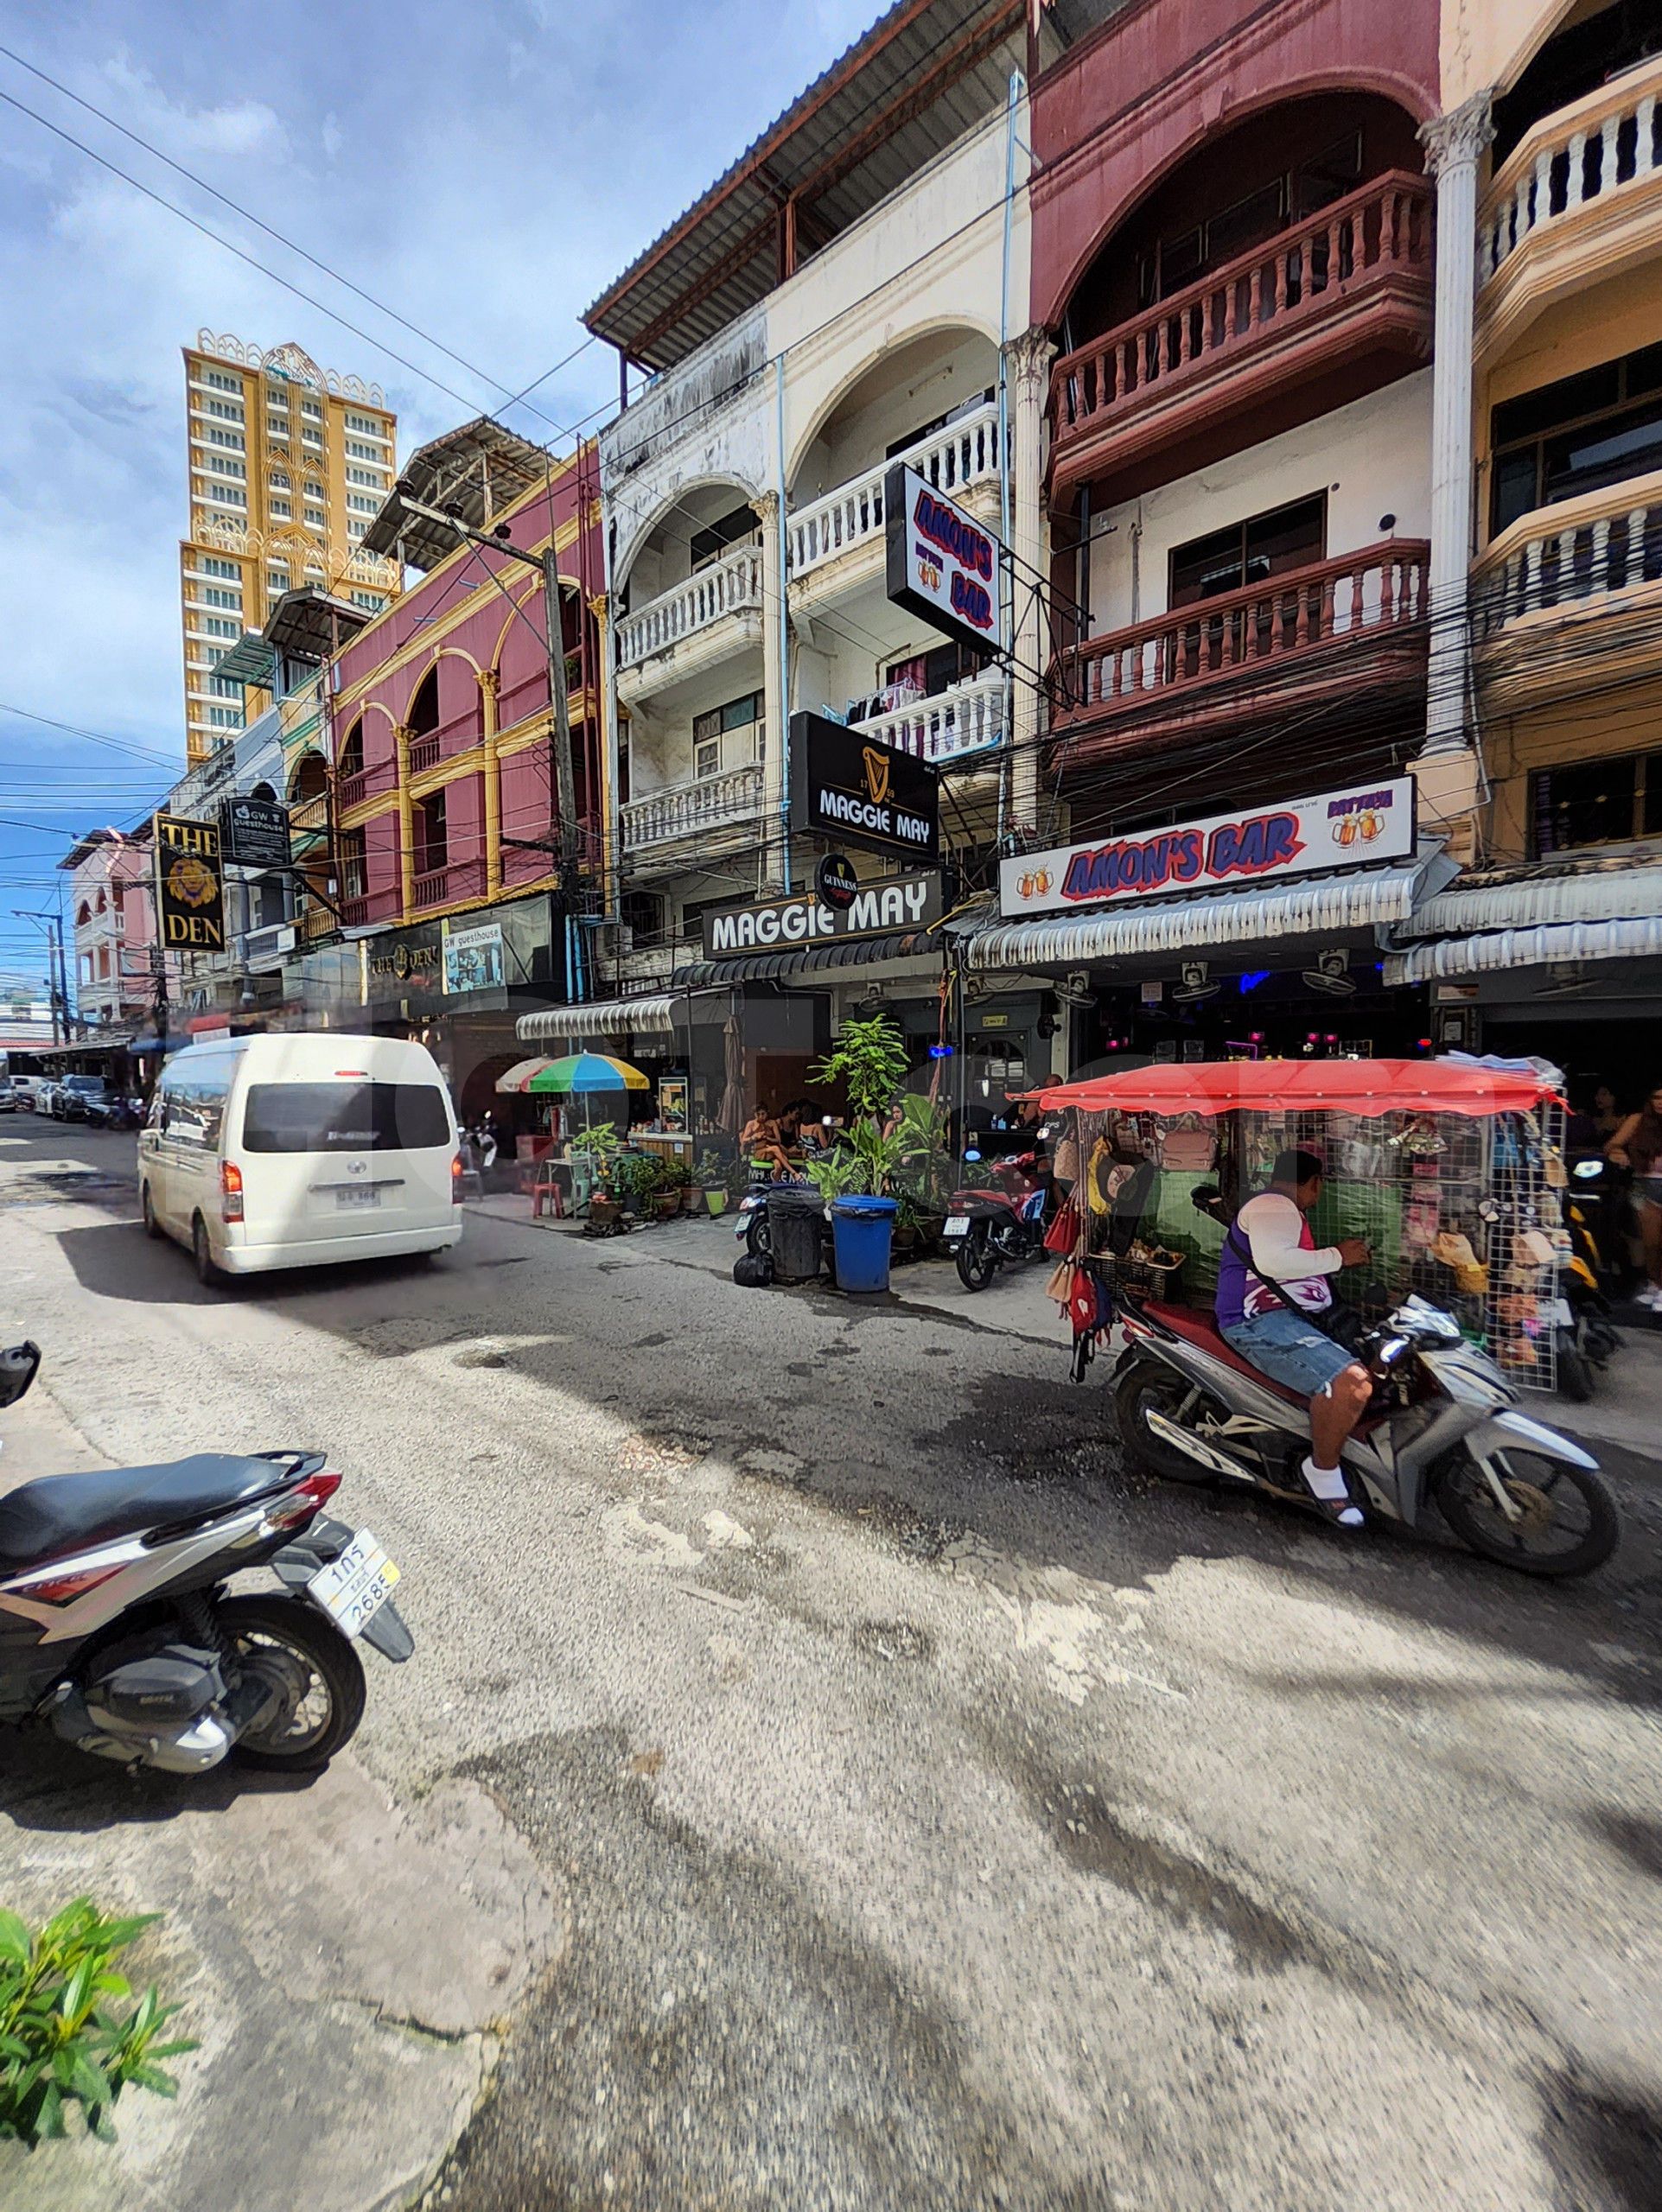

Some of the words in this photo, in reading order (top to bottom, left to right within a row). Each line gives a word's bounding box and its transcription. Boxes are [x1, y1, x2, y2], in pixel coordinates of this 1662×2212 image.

[951, 571, 993, 630] BAR
[233, 817, 284, 833] guesthouse
[820, 789, 891, 834] MAGGIE
[896, 814, 930, 844] MAY
[162, 823, 219, 857] THE
[1063, 830, 1203, 899] AMON'S
[1208, 813, 1302, 876] BAR
[824, 874, 857, 893] GUINNESS
[167, 914, 222, 945] DEN
[712, 904, 834, 950] MAGGIE
[847, 881, 927, 931] MAY
[444, 937, 455, 949] GW
[458, 929, 500, 946] guesthouse
